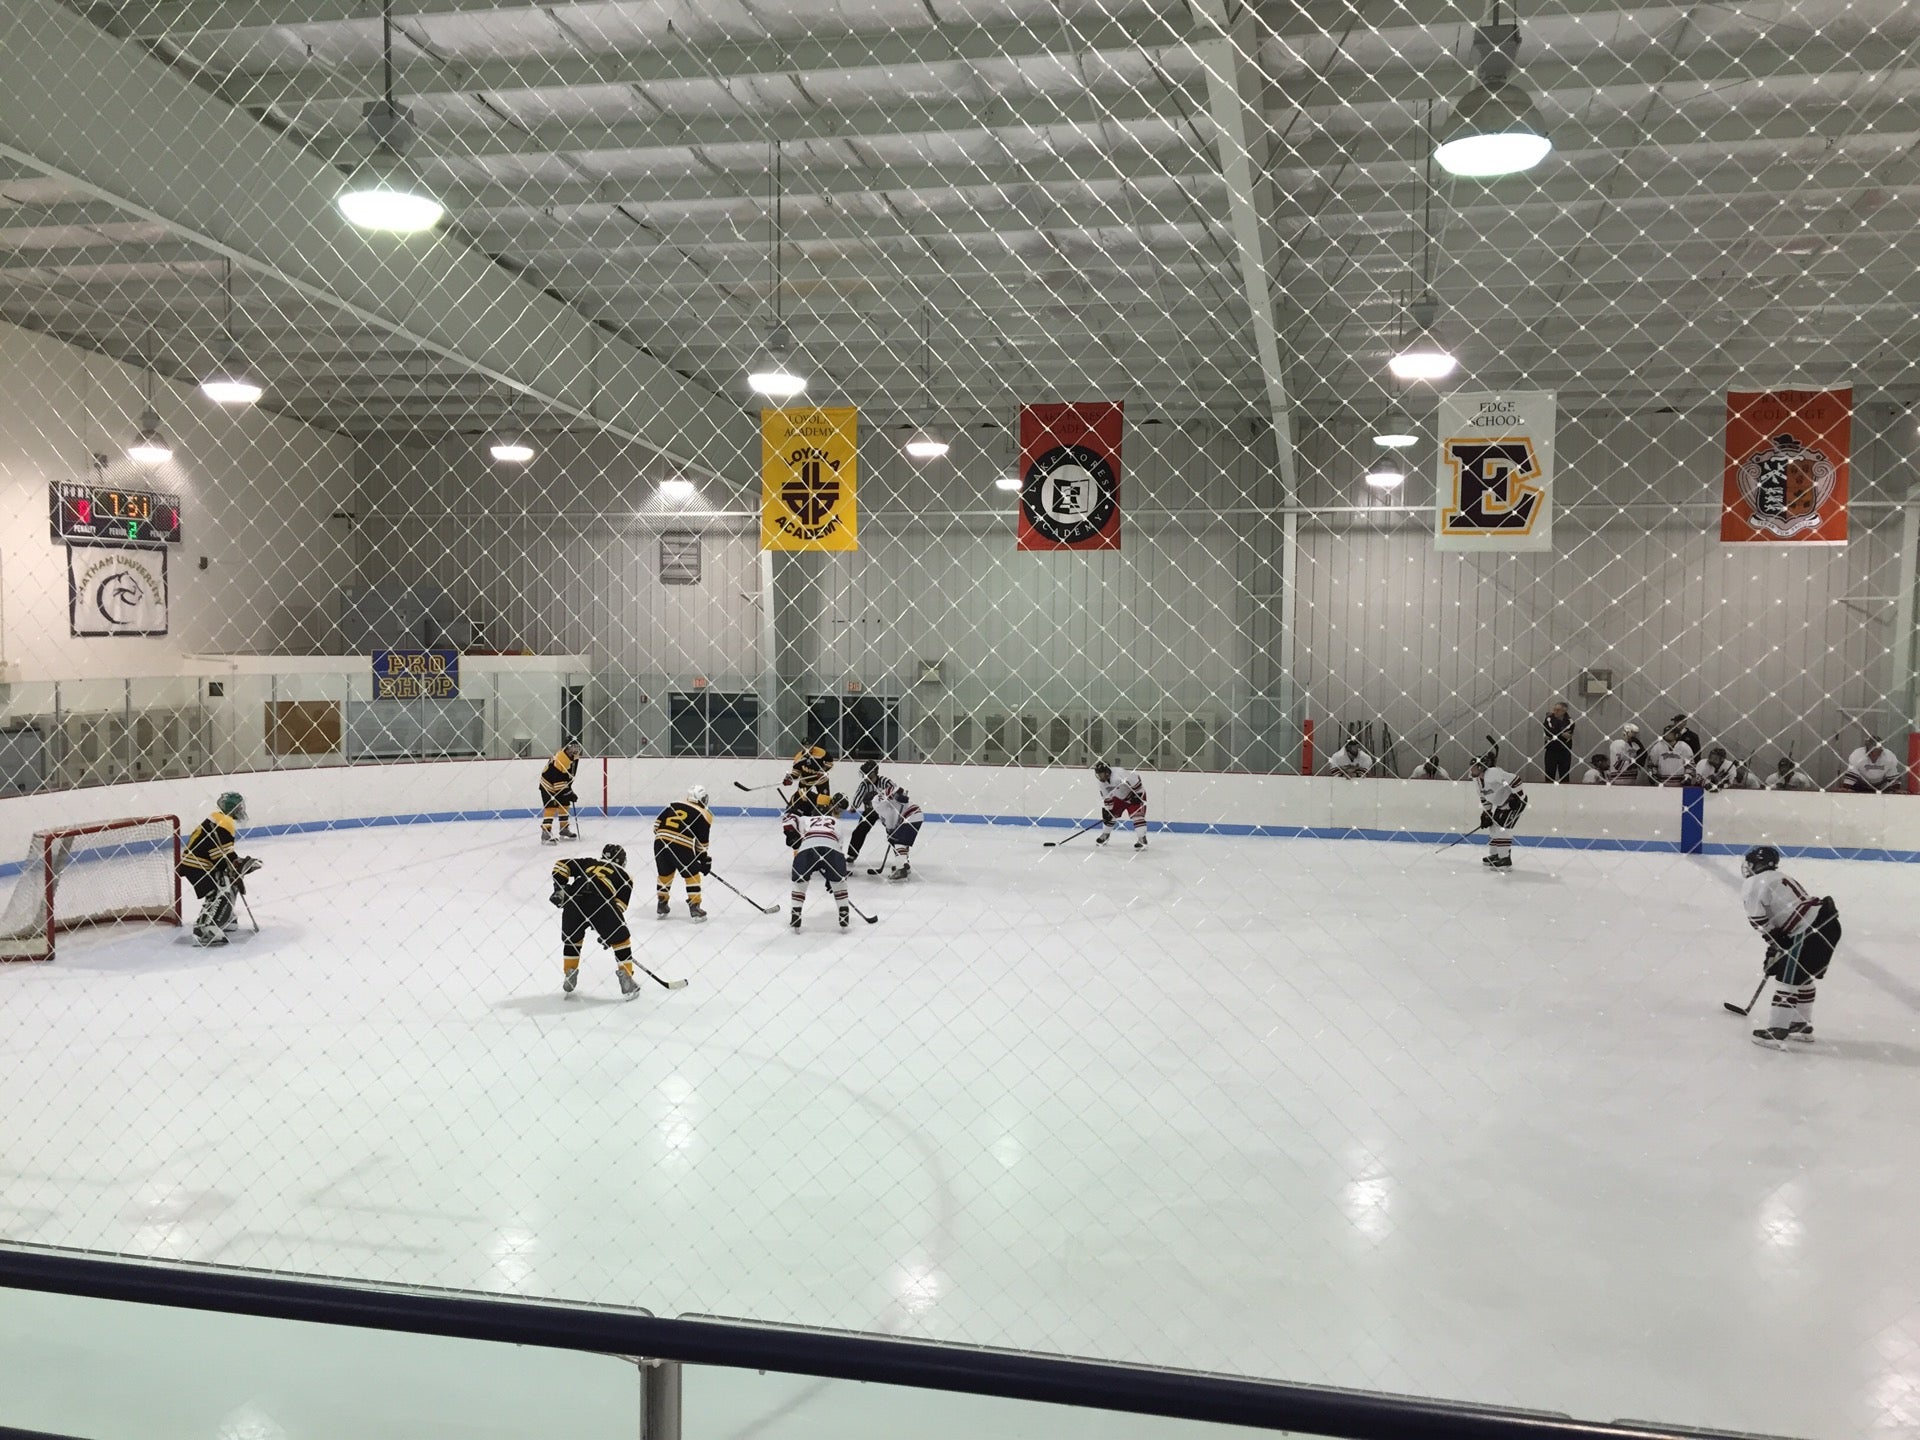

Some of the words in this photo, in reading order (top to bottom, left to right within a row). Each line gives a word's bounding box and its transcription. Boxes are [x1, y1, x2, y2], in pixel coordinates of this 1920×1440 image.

[1479, 401, 1515, 413] EDGE
[784, 446, 841, 472] LOYOLA
[774, 514, 843, 540] ACADEMY
[387, 654, 446, 675] PRO
[378, 676, 455, 698] SHOP
[665, 809, 688, 829] 2
